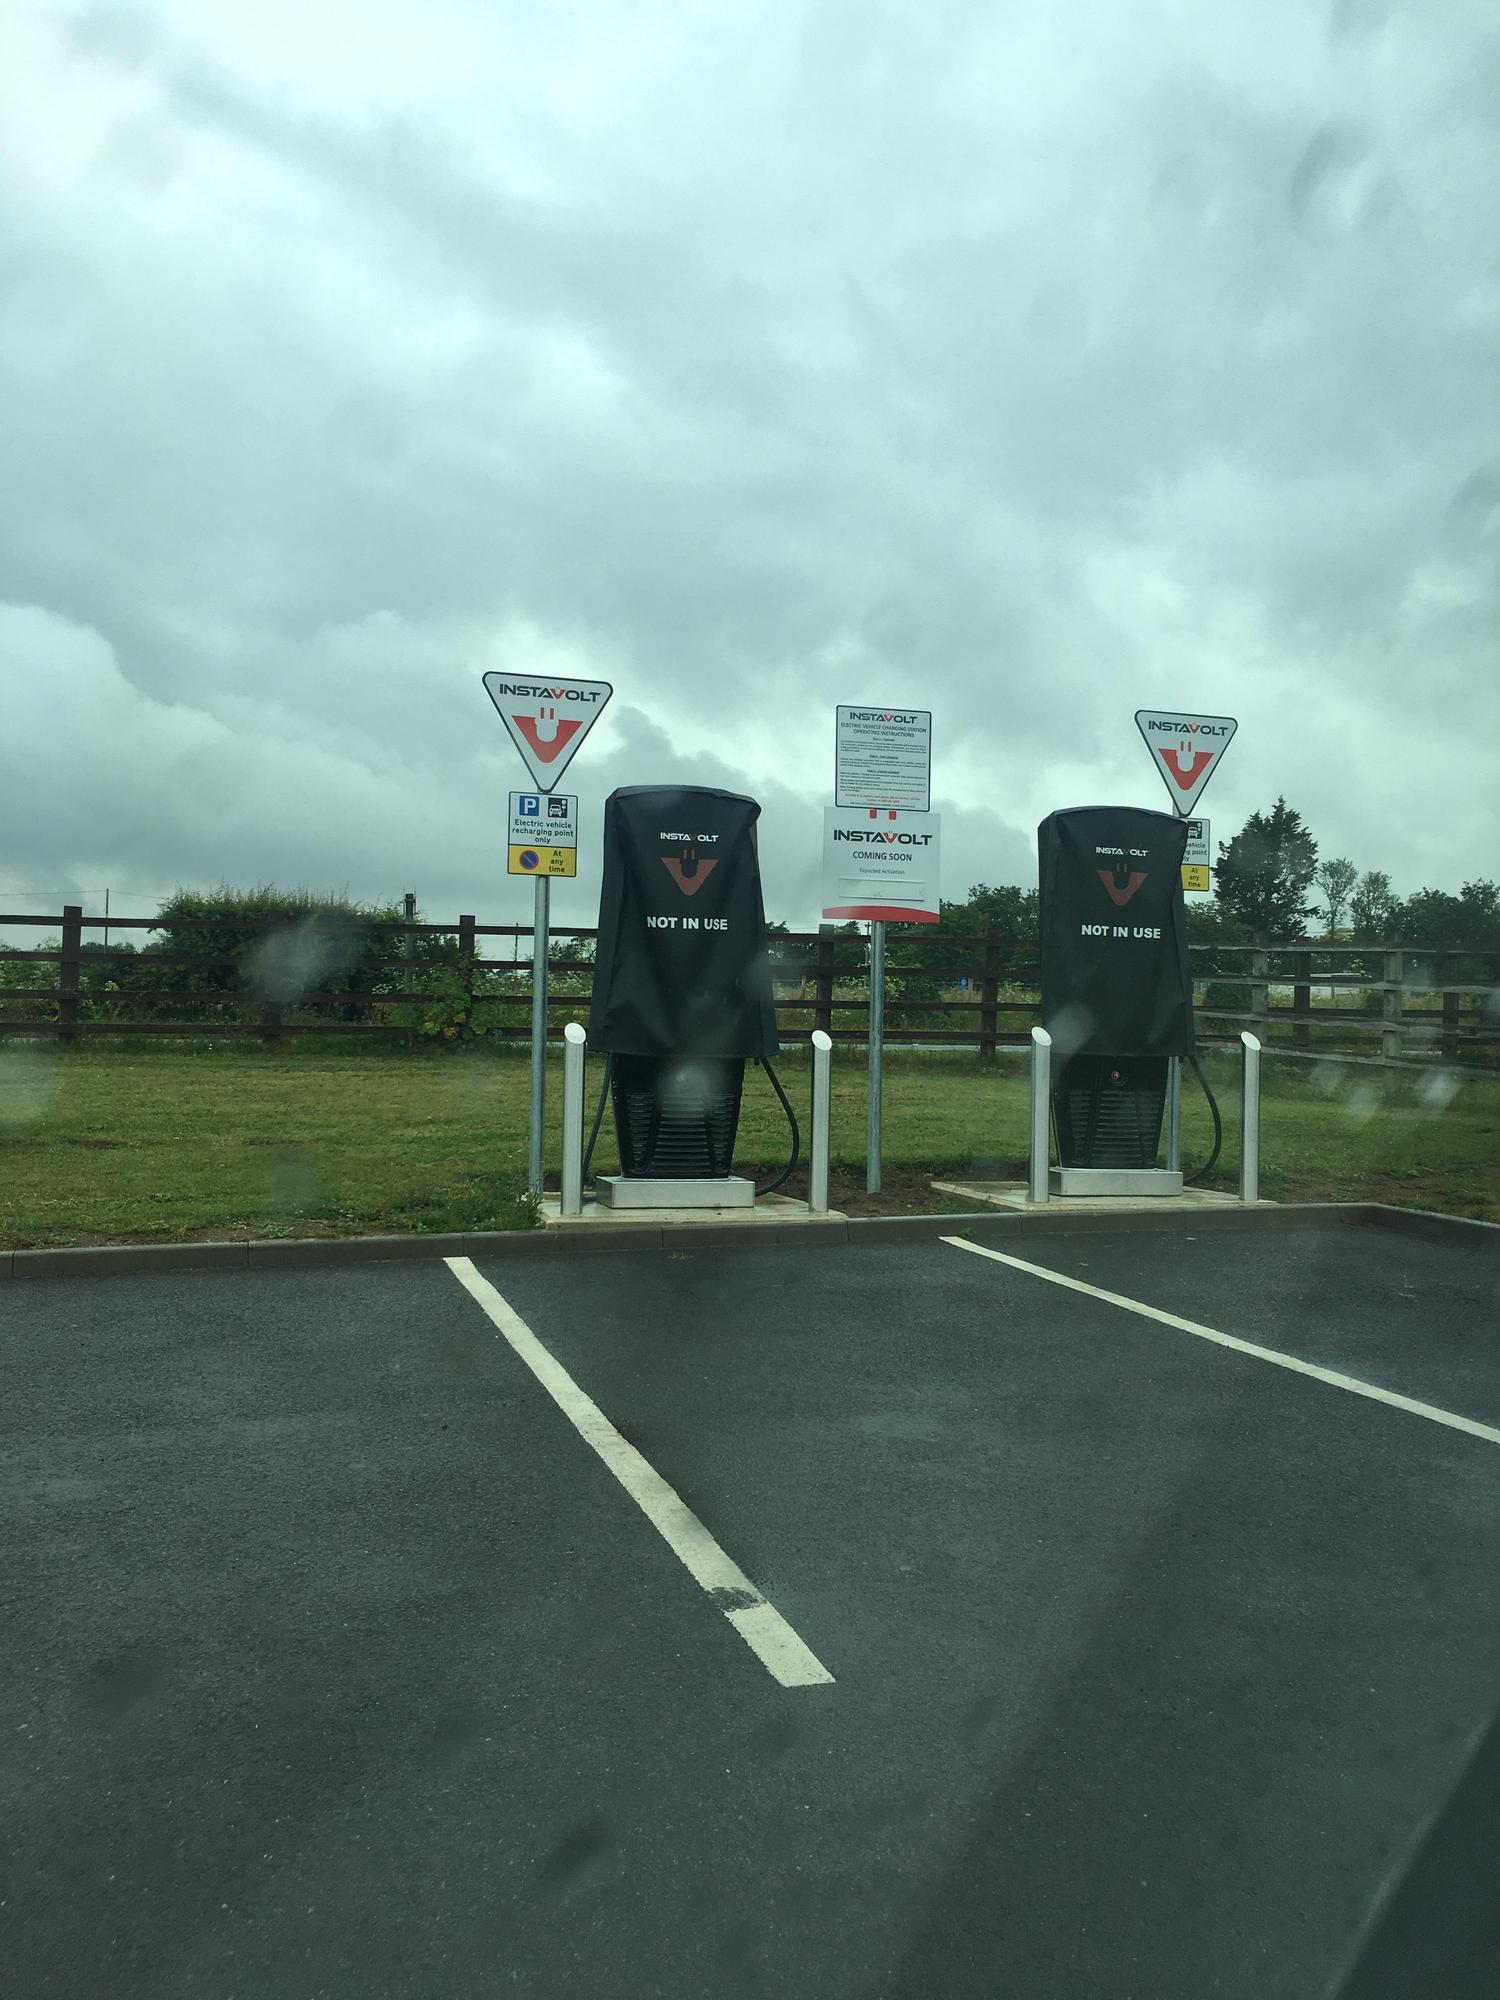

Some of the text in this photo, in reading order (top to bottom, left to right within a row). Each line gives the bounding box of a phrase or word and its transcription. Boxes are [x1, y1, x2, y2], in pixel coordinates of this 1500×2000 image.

[500, 683, 601, 702] INSTAVOLT
[849, 712, 917, 724] INSTAVOLT
[881, 730, 915, 738] INSTRUCTIONS
[1148, 720, 1229, 737] INSTAVOLT
[524, 798, 537, 814] P
[514, 819, 572, 829] Electric vehicle
[512, 828, 574, 837] recharging point
[833, 829, 933, 846] INSTAVOLT
[852, 851, 912, 861] COMING SOON
[646, 916, 728, 930] NOT IN USE
[1081, 924, 1161, 939] NOT IN USE
